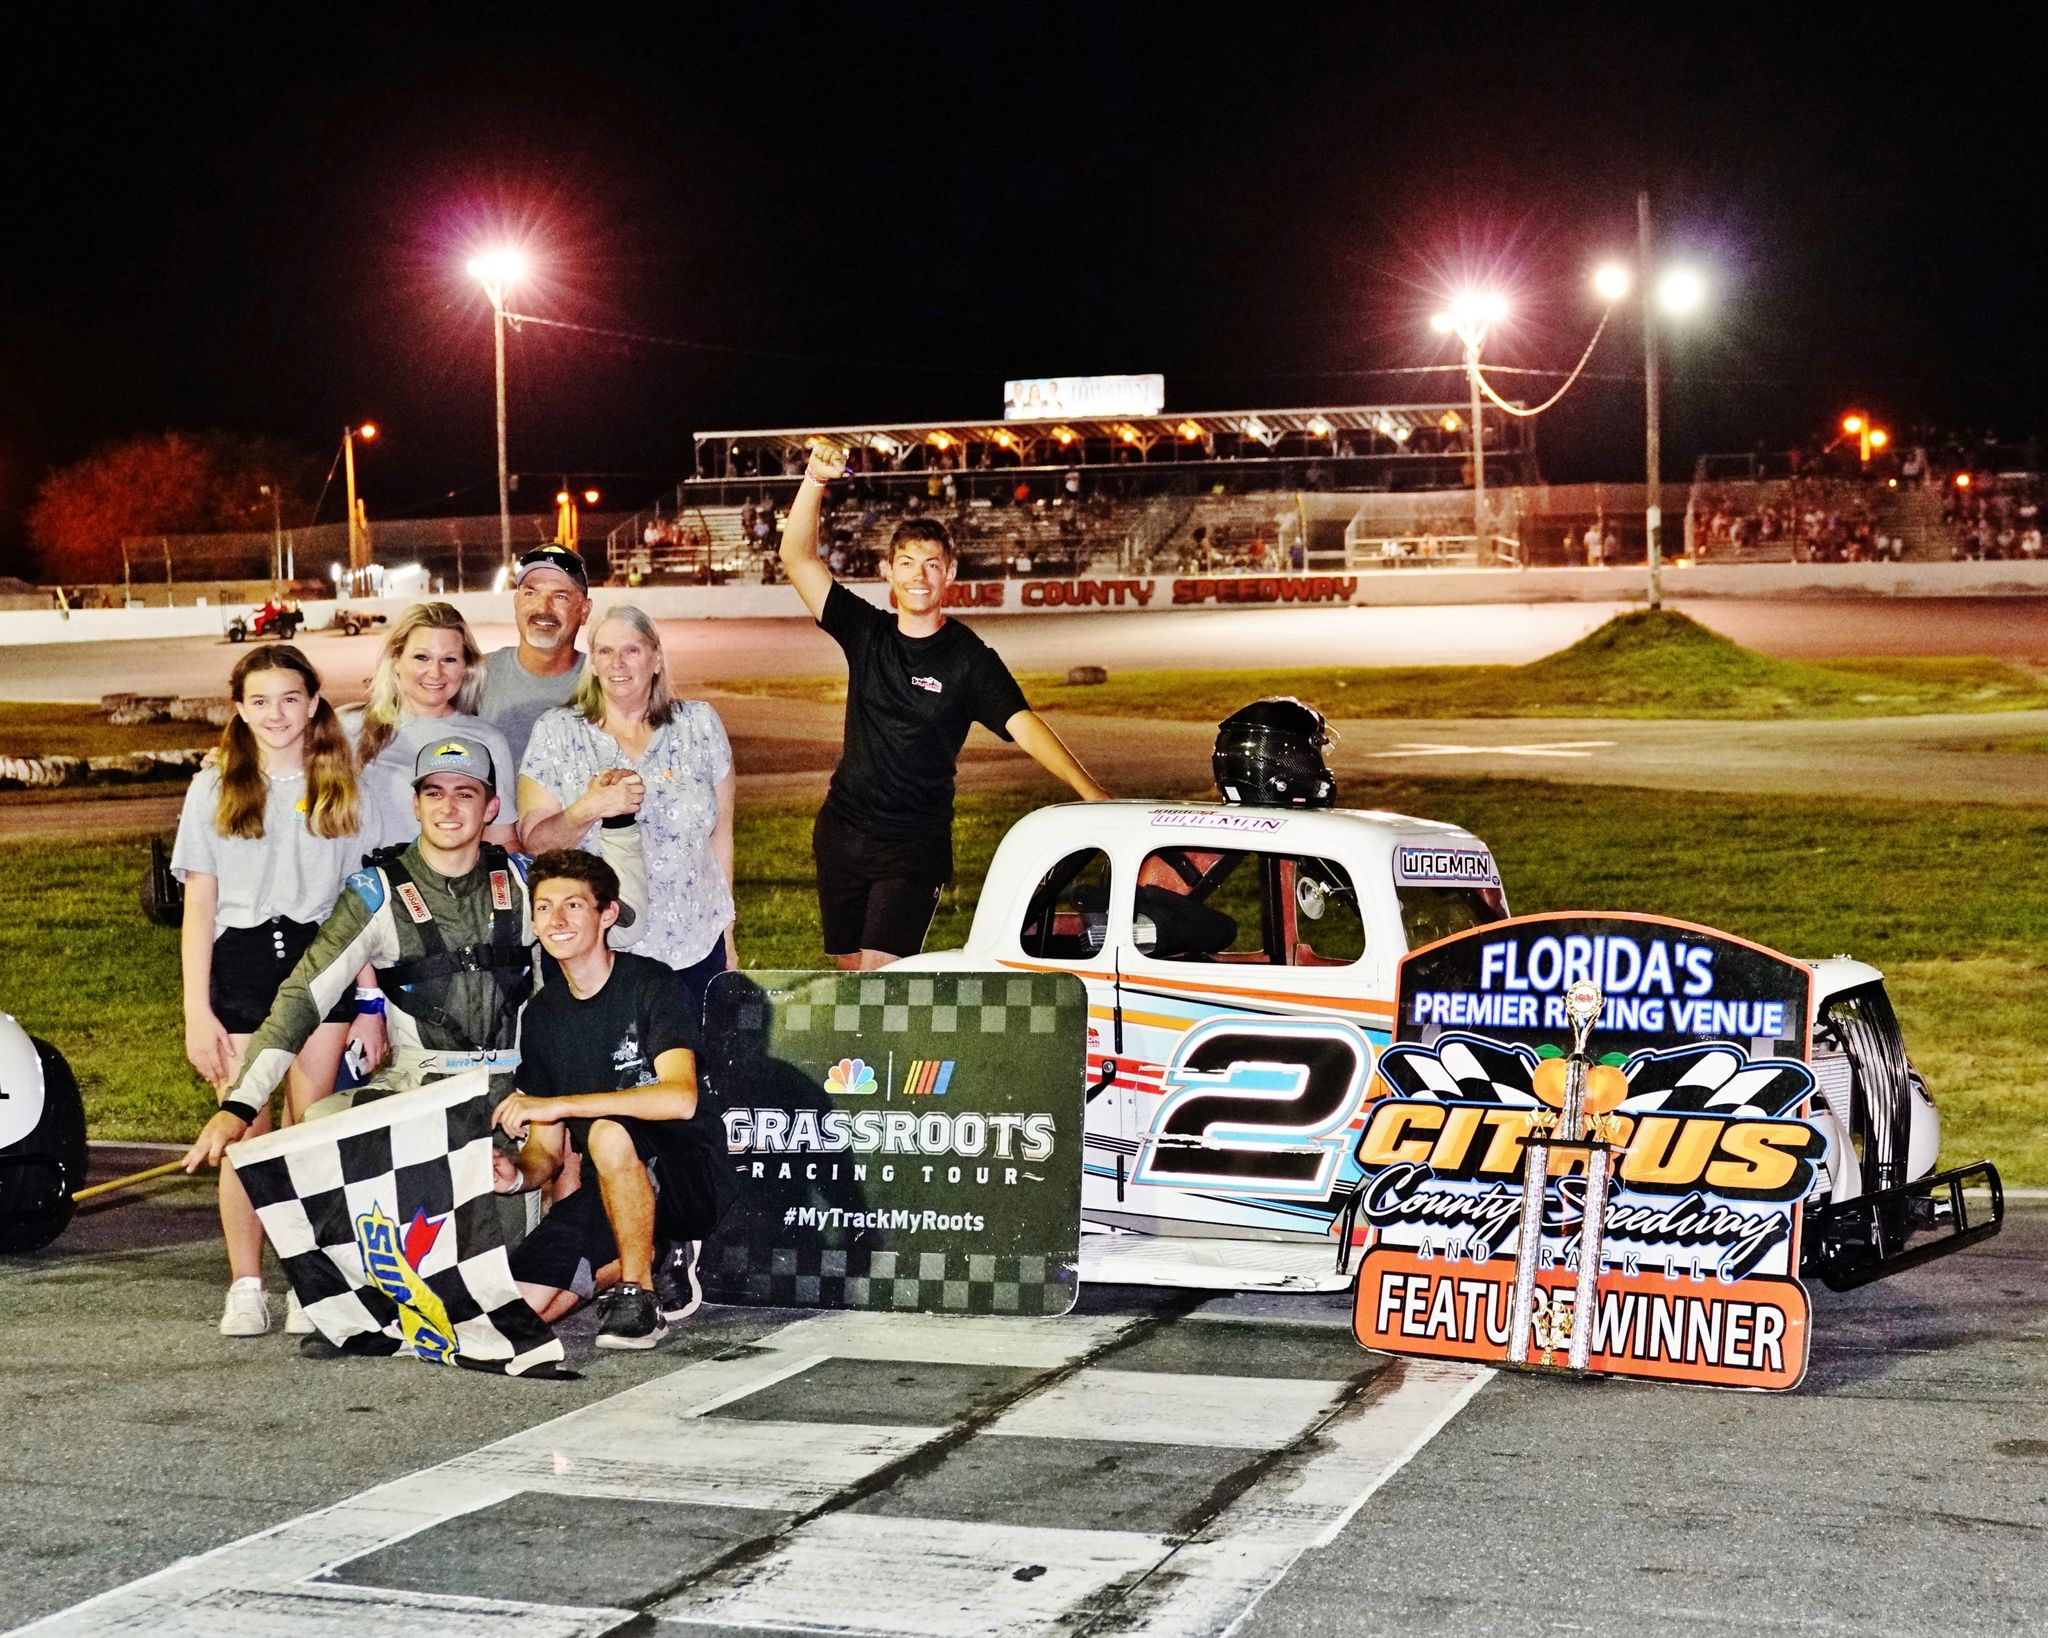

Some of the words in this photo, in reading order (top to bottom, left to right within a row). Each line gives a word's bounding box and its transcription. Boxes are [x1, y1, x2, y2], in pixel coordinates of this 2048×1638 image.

[912, 582, 1005, 608] RUS
[1022, 579, 1154, 606] COUNTY
[1173, 576, 1358, 604] SPEEDWAY
[1403, 852, 1490, 877] WAGMAN
[403, 887, 426, 919] SIMPSON
[1480, 936, 1714, 995] FLORIDA'S
[1414, 991, 1538, 1027] PREMIER
[1670, 999, 1785, 1035] VENUE
[1133, 1020, 1372, 1195] 2
[720, 1107, 1056, 1162] GRASSROOTS
[752, 1162, 895, 1183] RACING
[922, 1165, 1018, 1185] TOUR
[783, 1206, 984, 1234] #MyTrackMyRoots
[1362, 1164, 1523, 1250] County
[1420, 1239, 1487, 1262] AND
[1539, 1248, 1638, 1275] RACK
[1667, 1258, 1734, 1281] LLC
[1592, 1292, 1785, 1370] WINNER
